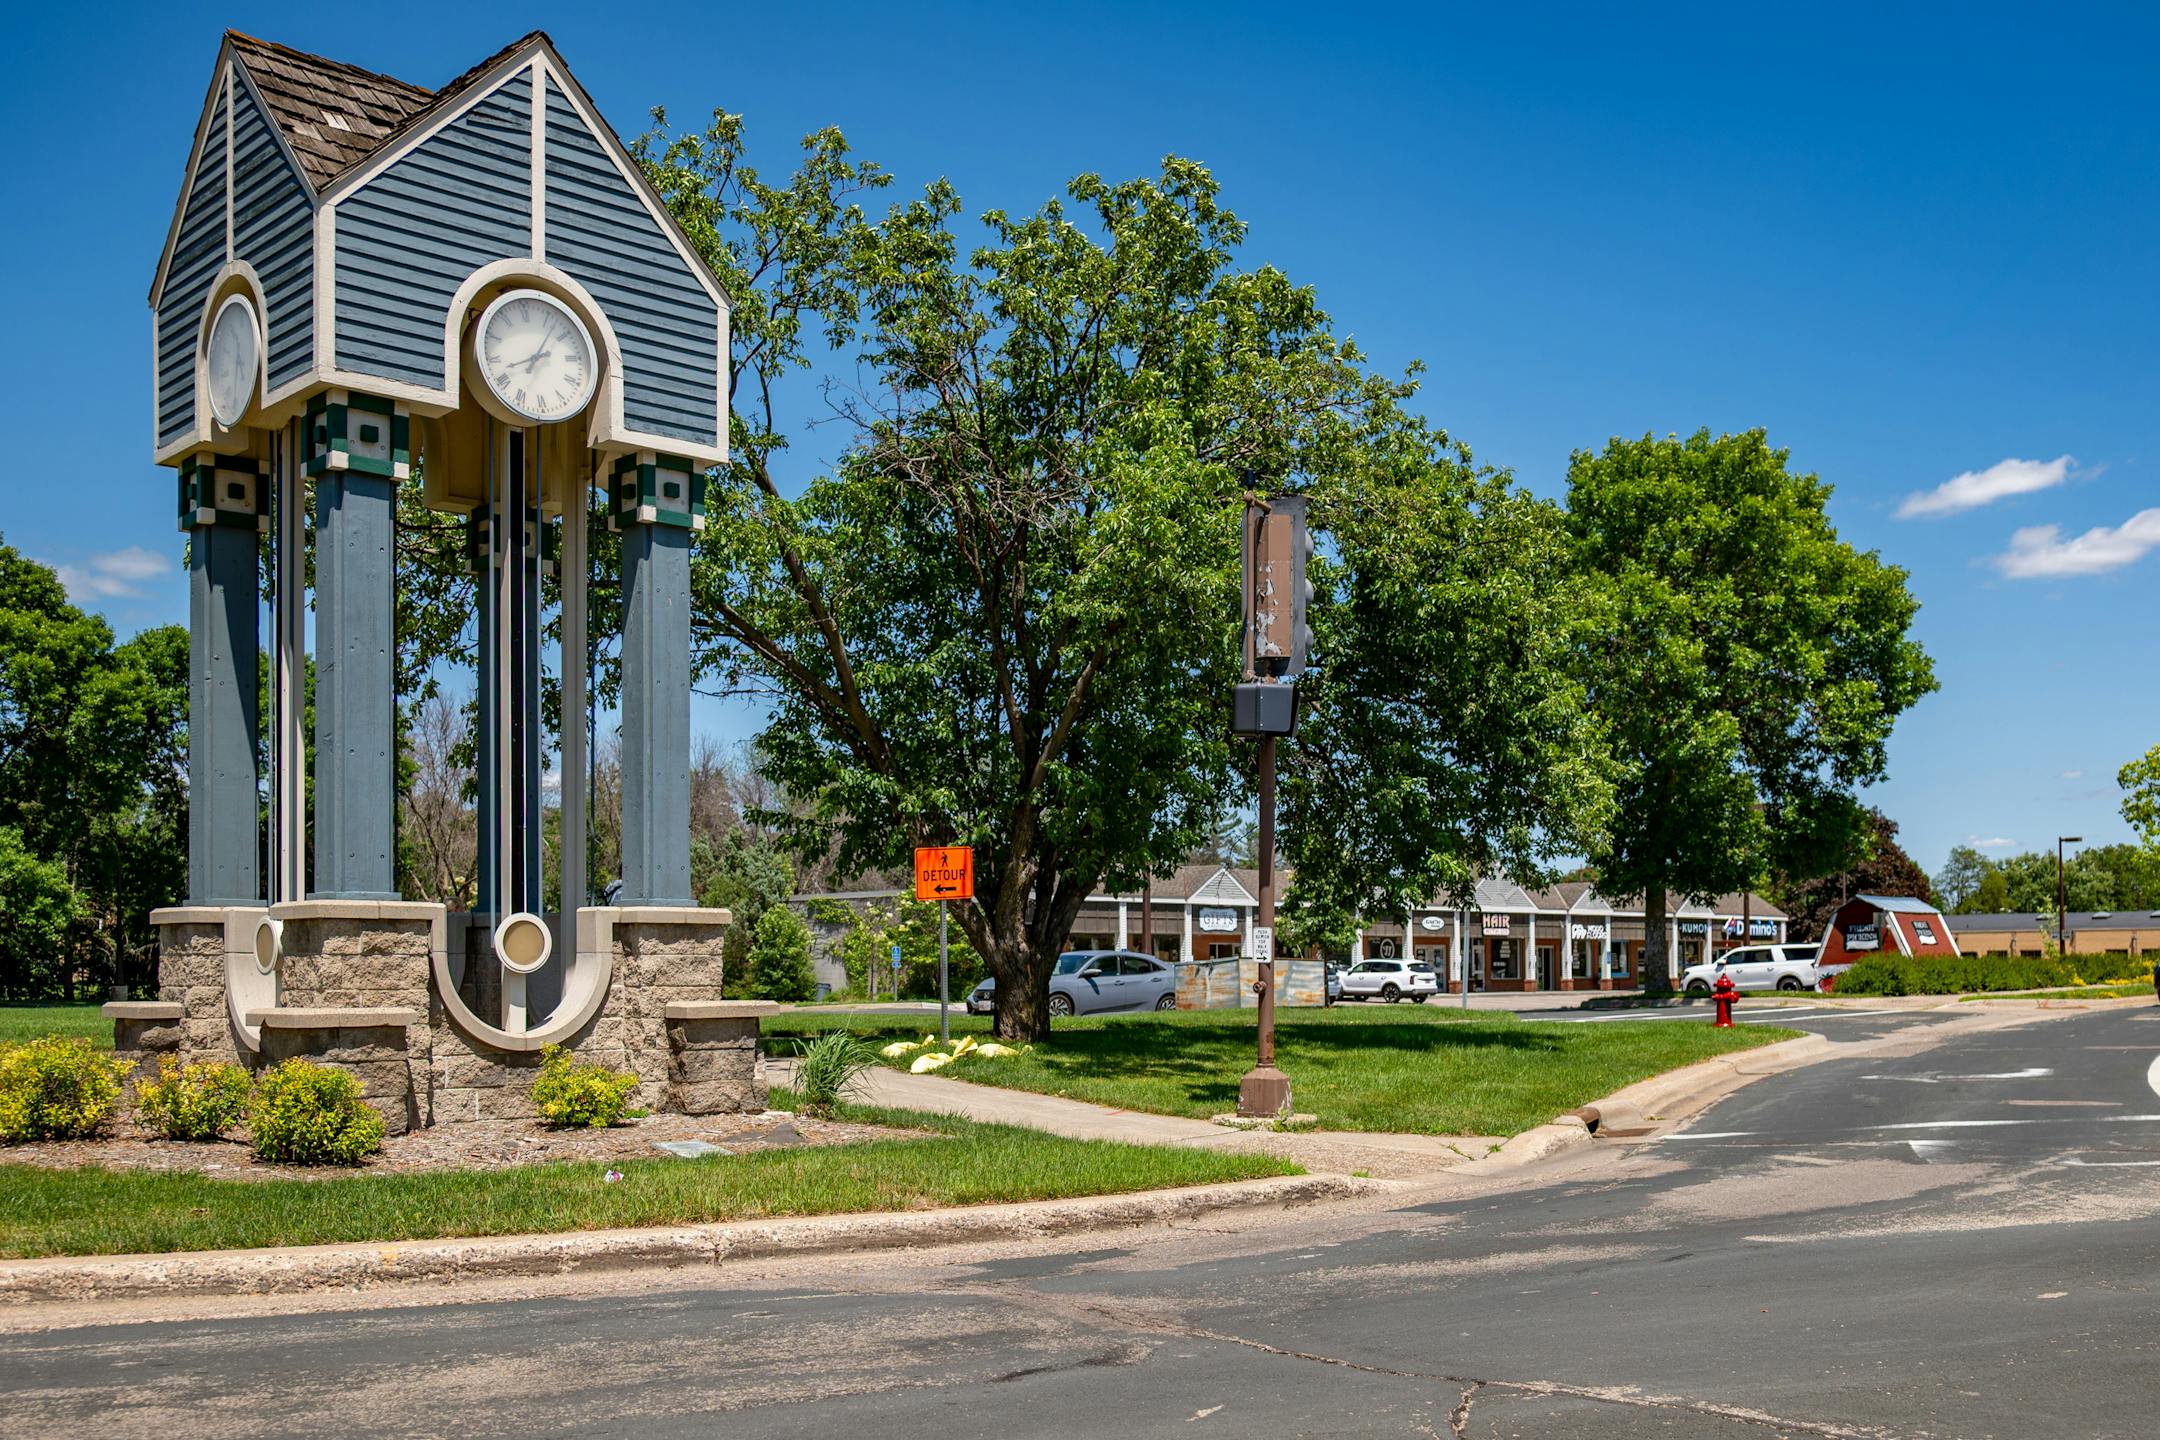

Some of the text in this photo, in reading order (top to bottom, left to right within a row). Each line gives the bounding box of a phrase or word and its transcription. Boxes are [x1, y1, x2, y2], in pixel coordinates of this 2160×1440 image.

[923, 869, 966, 882] DETOUR
[1203, 913, 1234, 925] GIFTS
[1482, 913, 1510, 928] HAIR
[1736, 919, 1777, 936] Dmino's
